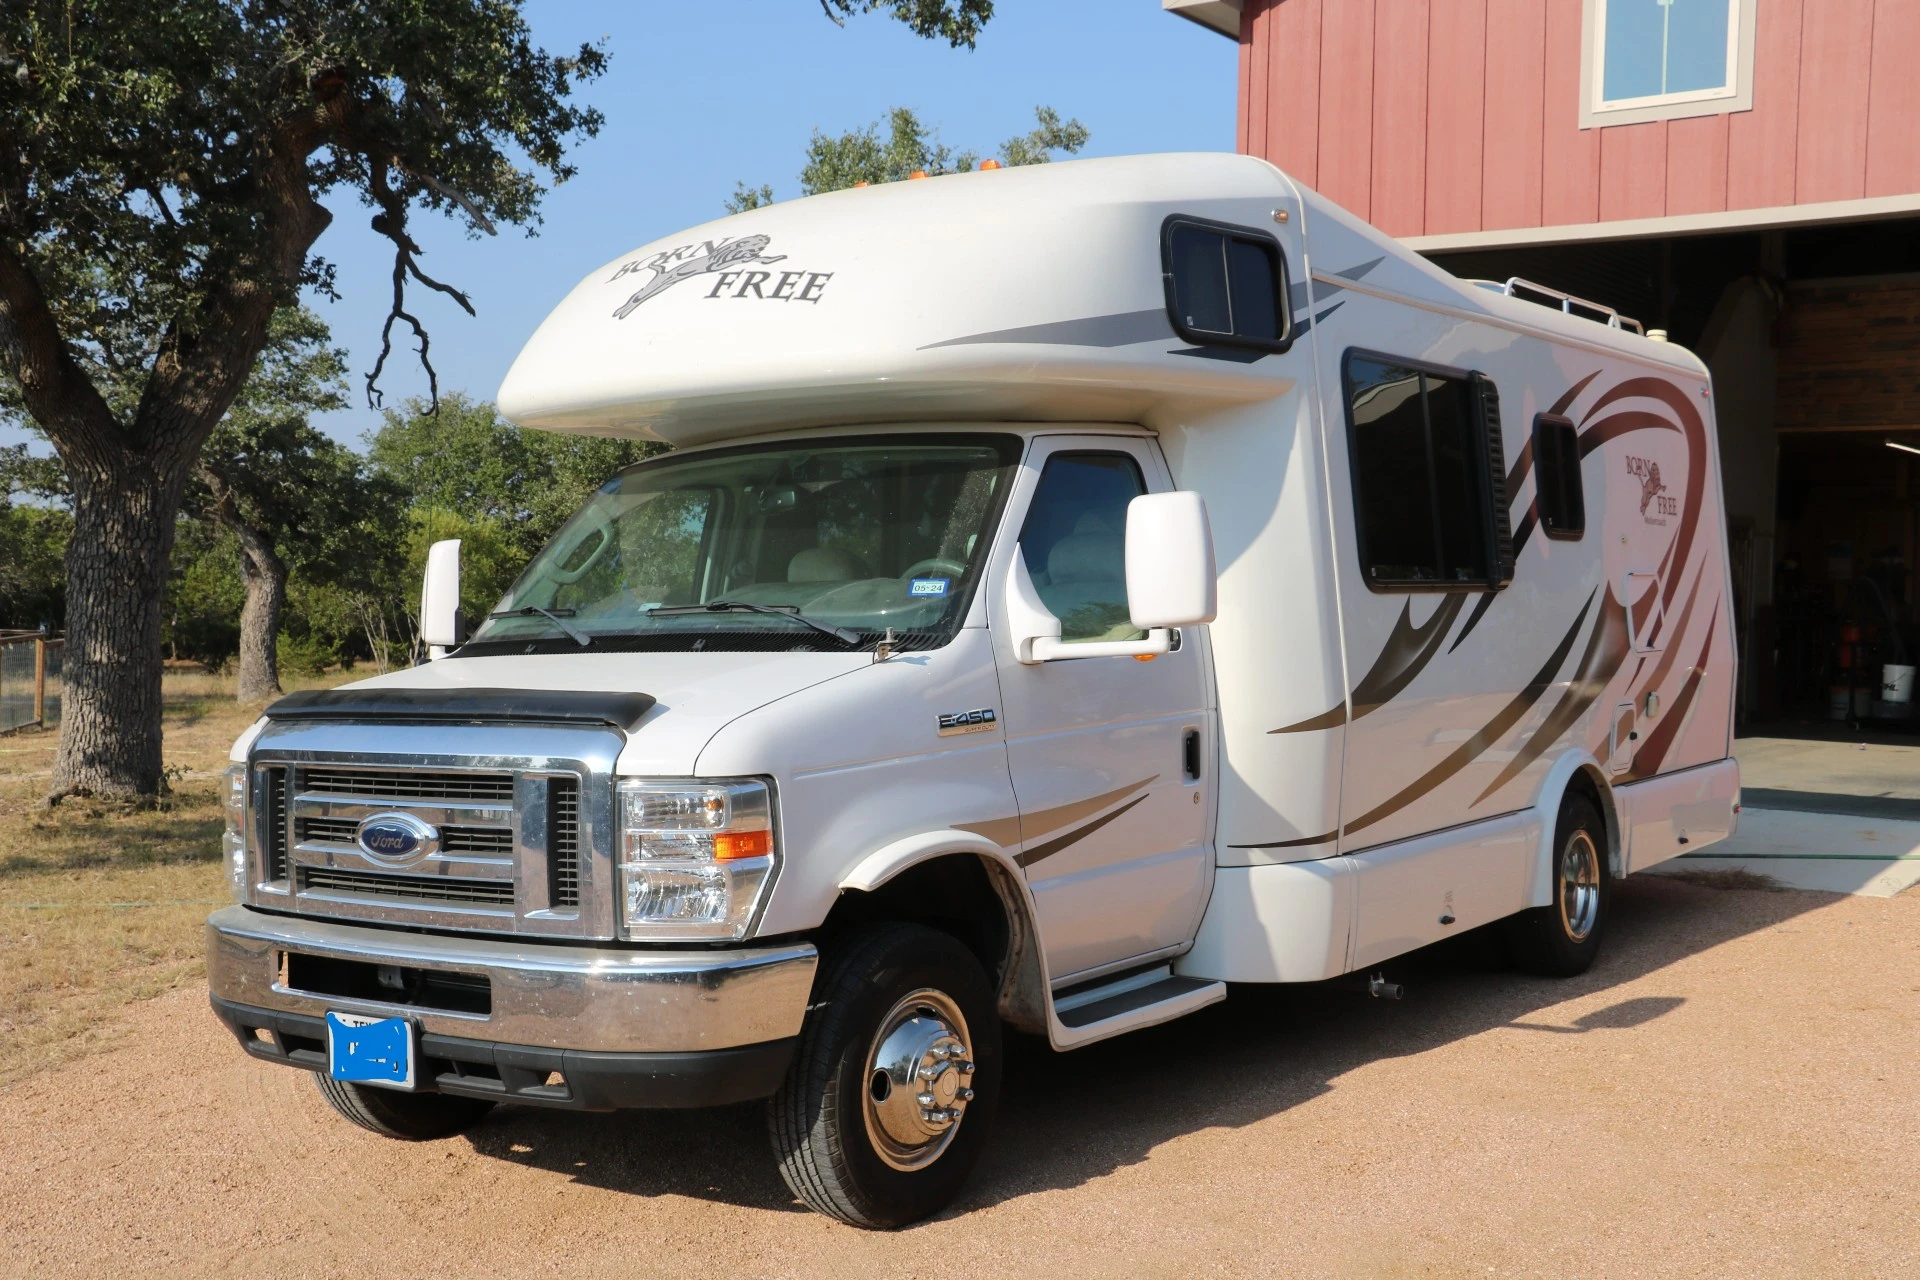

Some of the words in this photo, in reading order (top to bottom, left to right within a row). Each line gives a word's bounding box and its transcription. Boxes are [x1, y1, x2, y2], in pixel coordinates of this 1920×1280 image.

[605, 236, 736, 284] BORN
[703, 269, 835, 304] FREE
[1625, 455, 1651, 477] BORN
[1657, 495, 1677, 516] FREE
[370, 826, 405, 849] Ford
